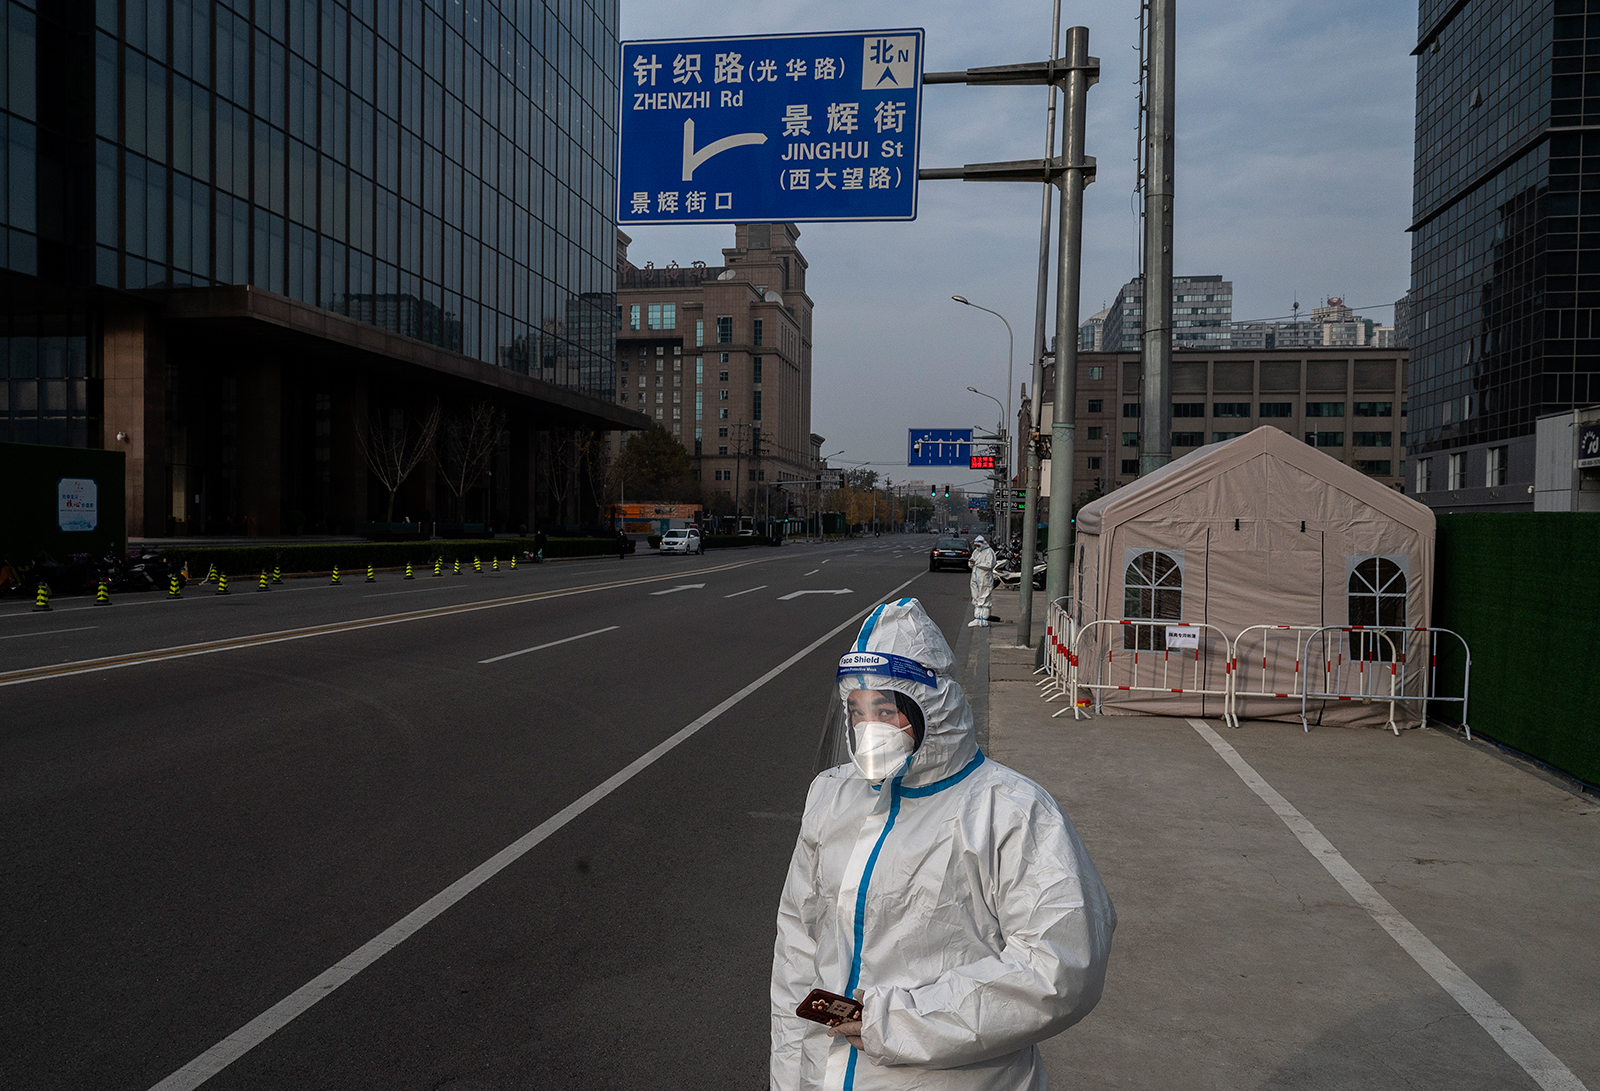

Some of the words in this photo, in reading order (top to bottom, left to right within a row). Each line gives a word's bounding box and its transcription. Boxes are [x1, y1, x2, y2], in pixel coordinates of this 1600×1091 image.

[870, 39, 894, 64] 北
[898, 49, 909, 63] N
[633, 91, 710, 110] ZHENZHI
[721, 90, 744, 108] Rd
[781, 101, 906, 137] 景辉街
[781, 141, 868, 161] JINGHUI
[881, 140, 904, 158] St
[779, 166, 902, 191] (西大望路)
[630, 191, 733, 214] 景辉街口
[841, 657, 853, 665] Face
[854, 655, 880, 664] Shield
